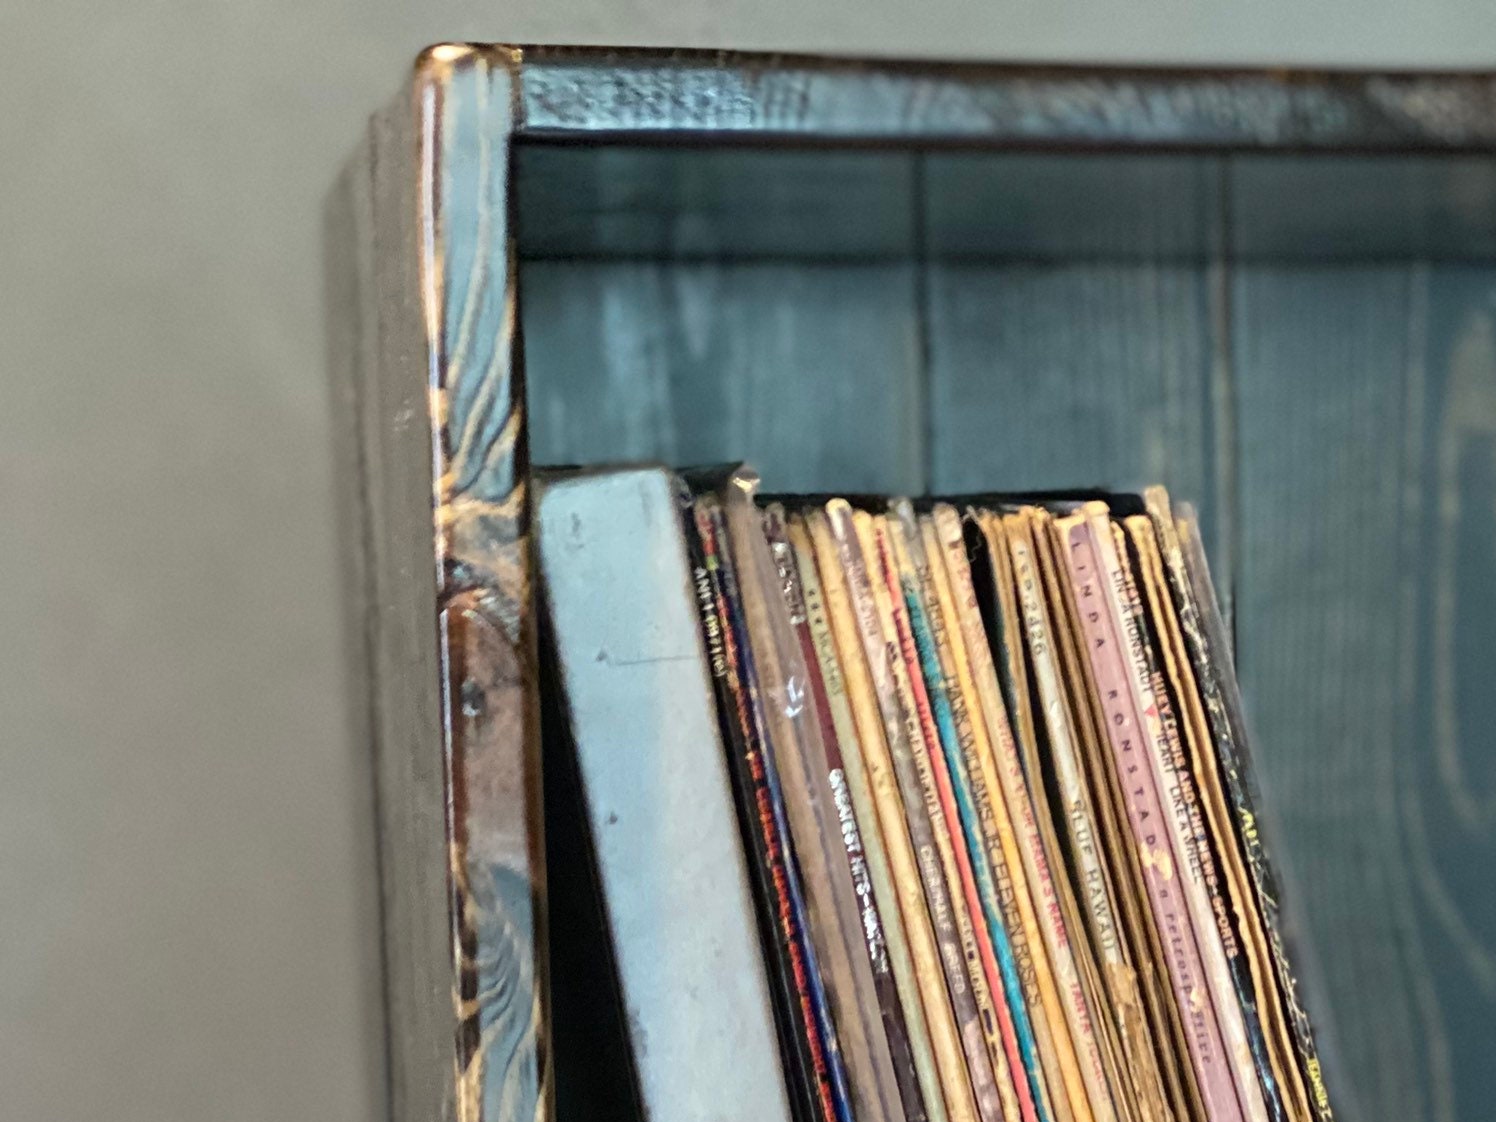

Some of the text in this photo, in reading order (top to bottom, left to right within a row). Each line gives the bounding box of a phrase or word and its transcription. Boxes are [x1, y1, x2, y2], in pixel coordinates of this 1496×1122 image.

[1070, 541, 1163, 865] LINDA RONSTAD
[1149, 670, 1171, 713] HUEY
[1175, 768, 1196, 805] AND
[824, 766, 862, 854] GREATEST
[956, 725, 994, 823] WILLIAMS
[990, 860, 1026, 943] ELEVEN
[1011, 940, 1044, 1010] ROSES
[1167, 784, 1187, 818] LIKE
[1177, 818, 1191, 832] A
